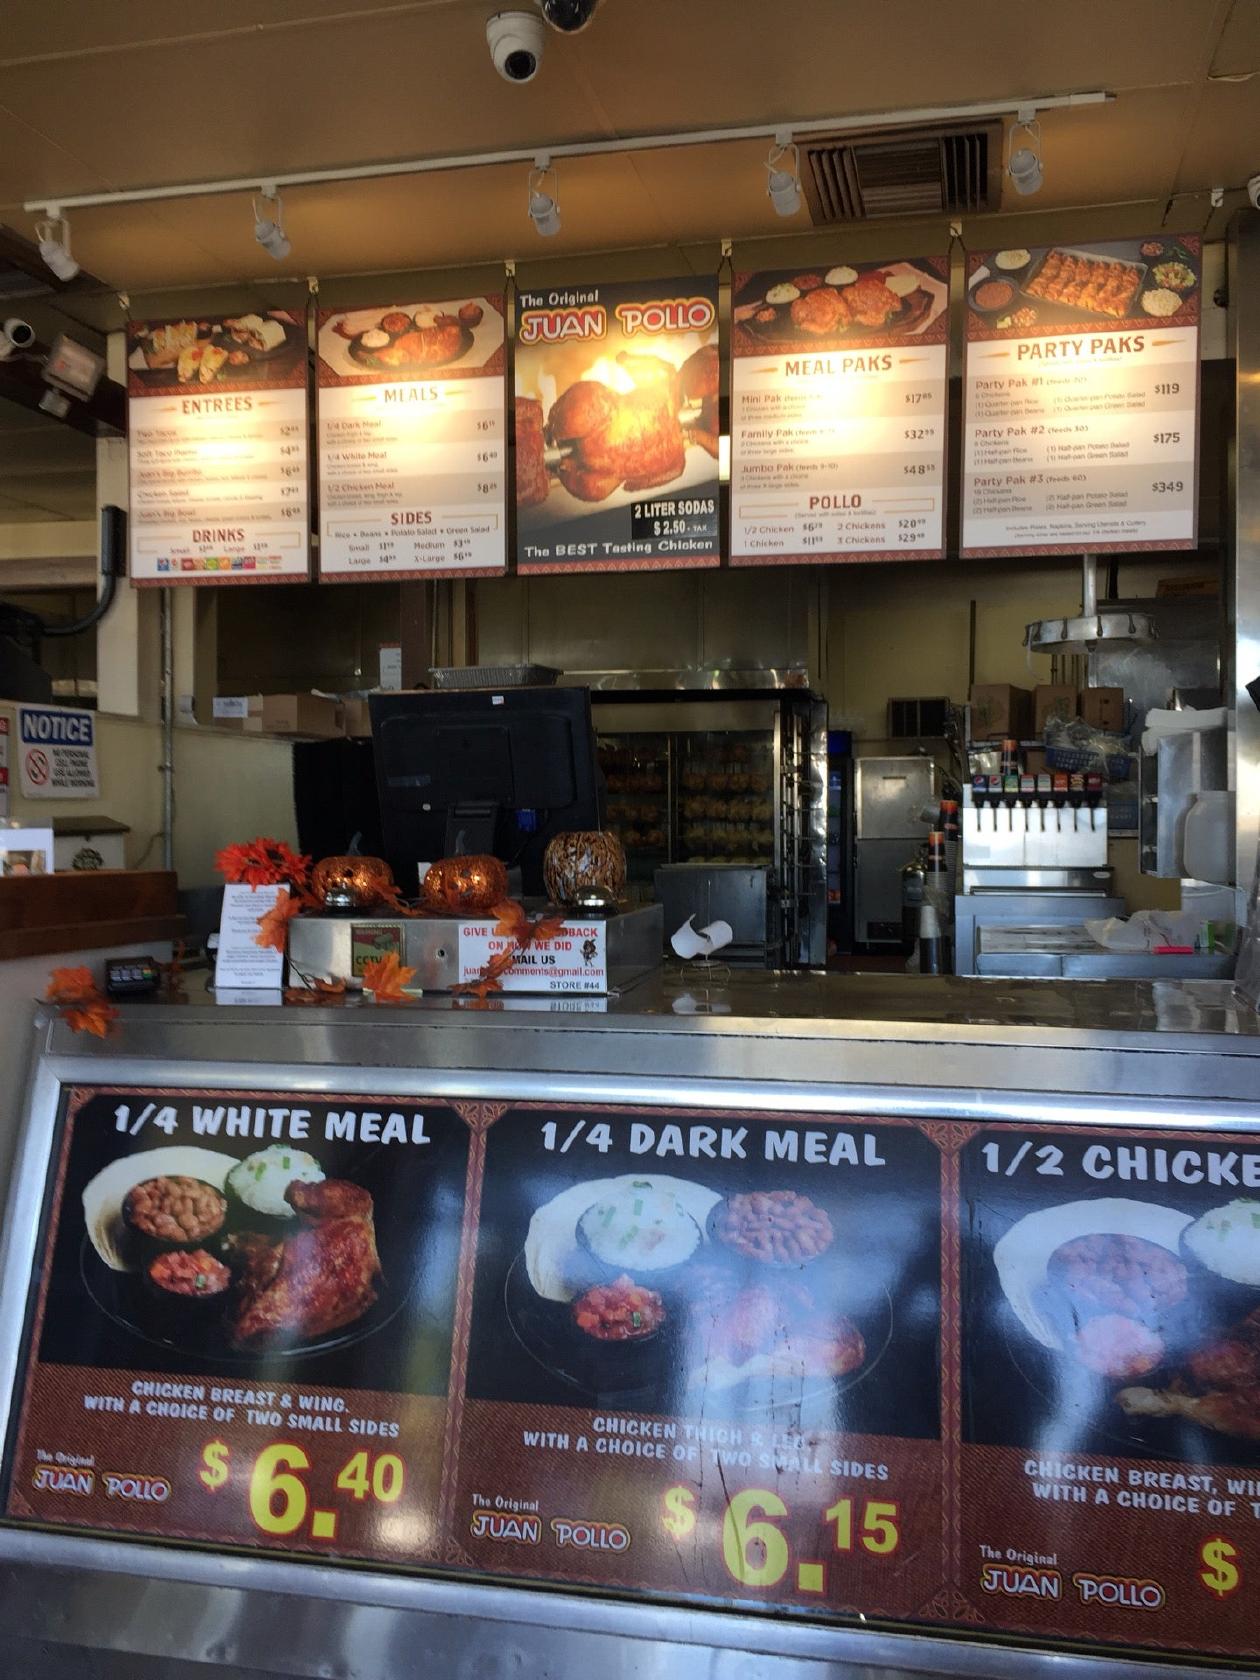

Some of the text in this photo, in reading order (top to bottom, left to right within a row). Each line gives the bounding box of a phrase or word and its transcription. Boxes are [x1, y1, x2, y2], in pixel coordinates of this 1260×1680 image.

[520, 290, 598, 308] The Original
[523, 303, 711, 341] JUAN POLLO
[1017, 336, 1145, 360] PARTY PAKS
[785, 355, 892, 377] MEAL PAKS
[975, 381, 1006, 390] Party
[1008, 378, 1028, 388] Pak
[1032, 377, 1044, 386] #1
[1154, 383, 1180, 395] $119
[182, 397, 252, 415] ENTREES
[742, 394, 781, 404] Mini Pak
[741, 428, 793, 439] Family Pak
[975, 429, 1003, 439] Party
[1007, 427, 1027, 436] Pak
[1031, 426, 1045, 435] #2
[1153, 432, 1181, 444] $175
[742, 464, 774, 474] Jumbo
[776, 462, 794, 472] Pak
[974, 477, 1002, 488] Party
[1006, 475, 1026, 485] Pak
[1029, 474, 1044, 484] #3
[1152, 481, 1184, 494] $349
[634, 499, 715, 519] 2 LITER SODAS
[809, 494, 862, 510] POLLO
[391, 511, 432, 526] SIDES
[845, 522, 886, 530] Chickens
[192, 528, 246, 544] DRINKS
[759, 525, 794, 534] Chicken
[414, 542, 445, 550] Medium
[524, 539, 713, 558] The BEST Tasting Chicken
[750, 538, 784, 548] Chicken
[845, 535, 886, 544] Chickens
[23, 713, 91, 742] NOTICE
[463, 928, 488, 937] GIVE
[488, 942, 504, 950] ON
[534, 941, 550, 950] WE
[554, 941, 572, 950] DID
[542, 954, 556, 964] US
[550, 981, 600, 990] STORE #44
[114, 1102, 431, 1145] 1/4 WHITE MEAL
[540, 1119, 886, 1166] 1/4 DARK MEAL
[981, 1140, 1064, 1176] 1/2
[130, 1379, 203, 1401] CHICKEN
[210, 1386, 276, 1407] BREAST
[279, 1393, 292, 1408] &
[84, 1394, 400, 1438] WITH A CHOICE OF TWO SMALL SIDES
[592, 1416, 677, 1441] CHICKEN
[36, 1449, 95, 1468] The Original
[523, 1430, 889, 1482] WITH A CHOICE OF TWO SMALL SIDES
[34, 1468, 169, 1502] JUAN POLLO
[1024, 1459, 1120, 1484] CHICKEN
[1128, 1470, 1218, 1495] BREAST,
[472, 1494, 539, 1514] The Original
[1032, 1482, 1087, 1503] WITH
[1095, 1488, 1110, 1504] A
[1117, 1490, 1200, 1514] CHOICE
[1207, 1500, 1236, 1517] OF
[472, 1514, 628, 1551] JUAN POLLO
[979, 1544, 1057, 1566] The Original
[1202, 1538, 1239, 1597] $
[982, 1569, 1162, 1608] JUAN POLLO
